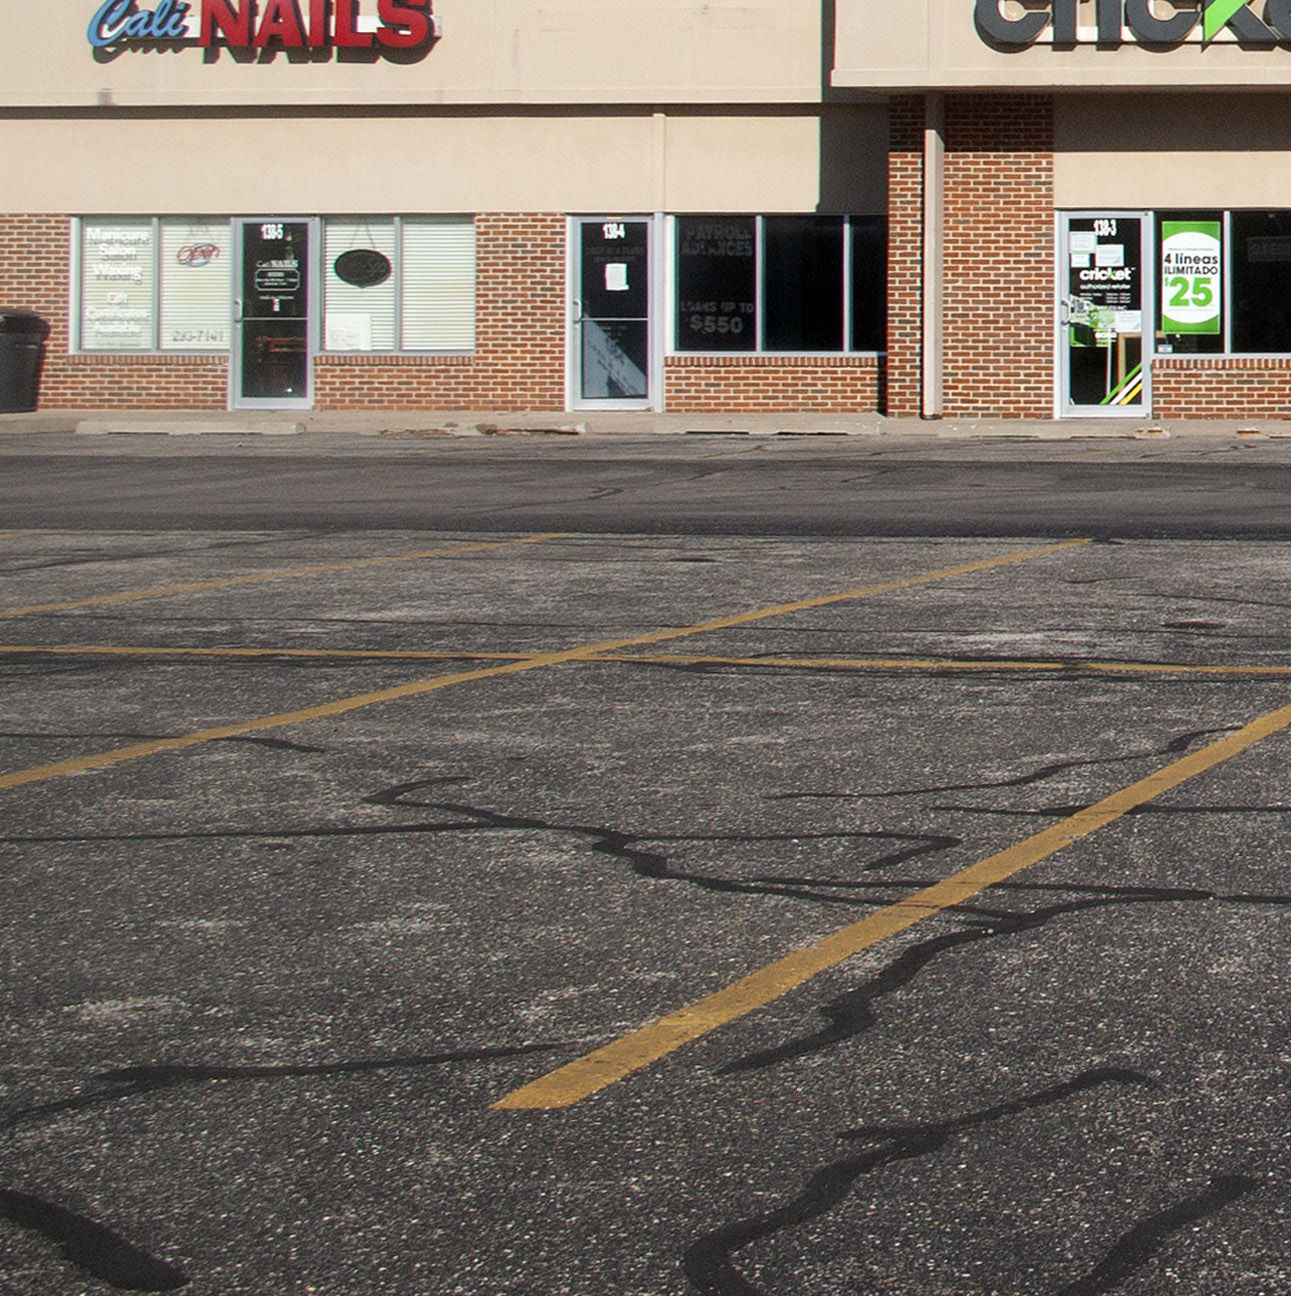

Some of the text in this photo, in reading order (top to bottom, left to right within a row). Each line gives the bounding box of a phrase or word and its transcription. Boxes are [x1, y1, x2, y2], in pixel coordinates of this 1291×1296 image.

[86, 227, 150, 242] Manicure
[99, 244, 137, 256] Salon
[1164, 252, 1219, 265] 4 líneas
[92, 263, 142, 281] Waxing
[1079, 267, 1132, 280] cricket
[1164, 266, 1219, 275] ILIMITADO
[688, 315, 744, 334] $550
